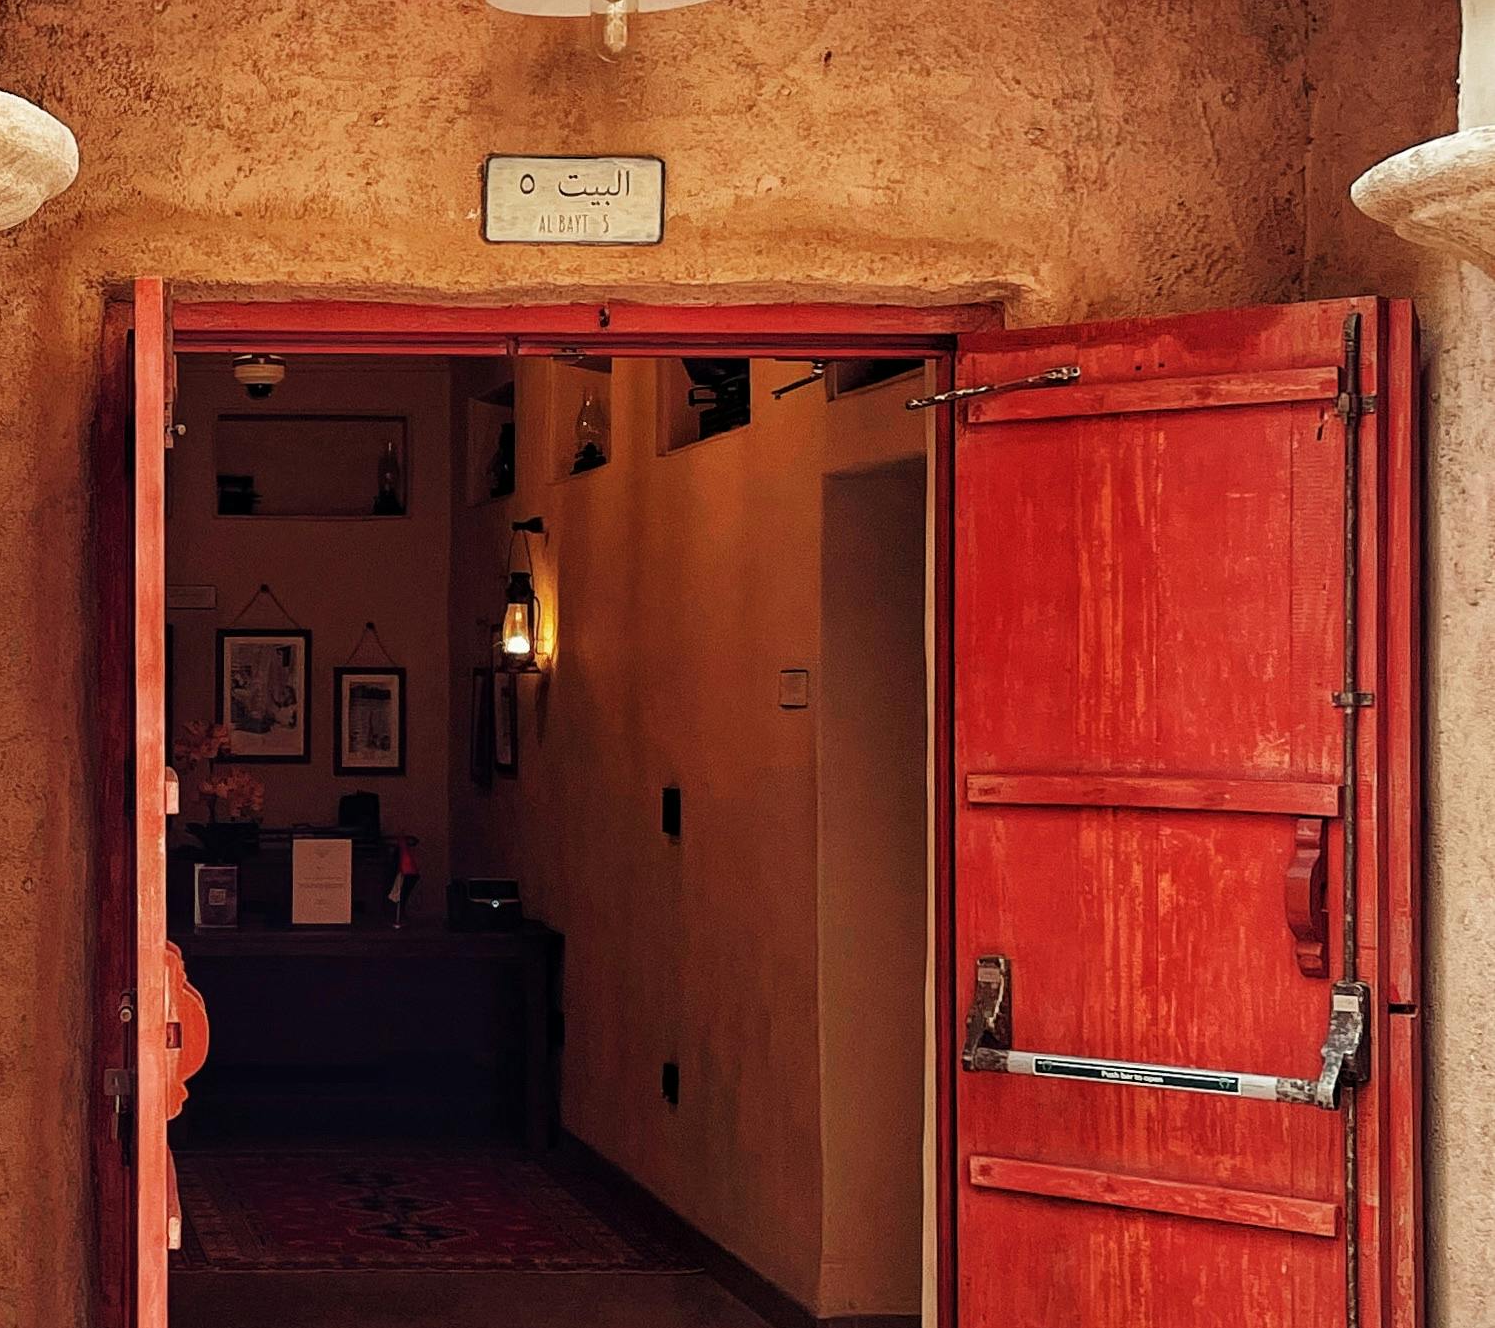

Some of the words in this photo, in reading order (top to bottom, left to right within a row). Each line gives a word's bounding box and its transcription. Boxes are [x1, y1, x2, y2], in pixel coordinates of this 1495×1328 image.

[519, 173, 535, 195] ٥
[558, 170, 630, 206] البيت
[538, 214, 553, 233] AL
[559, 214, 588, 233] BAYT
[1101, 1070, 1120, 1079] Push
[1120, 1072, 1133, 1080] bar
[1143, 1075, 1164, 1083] open
